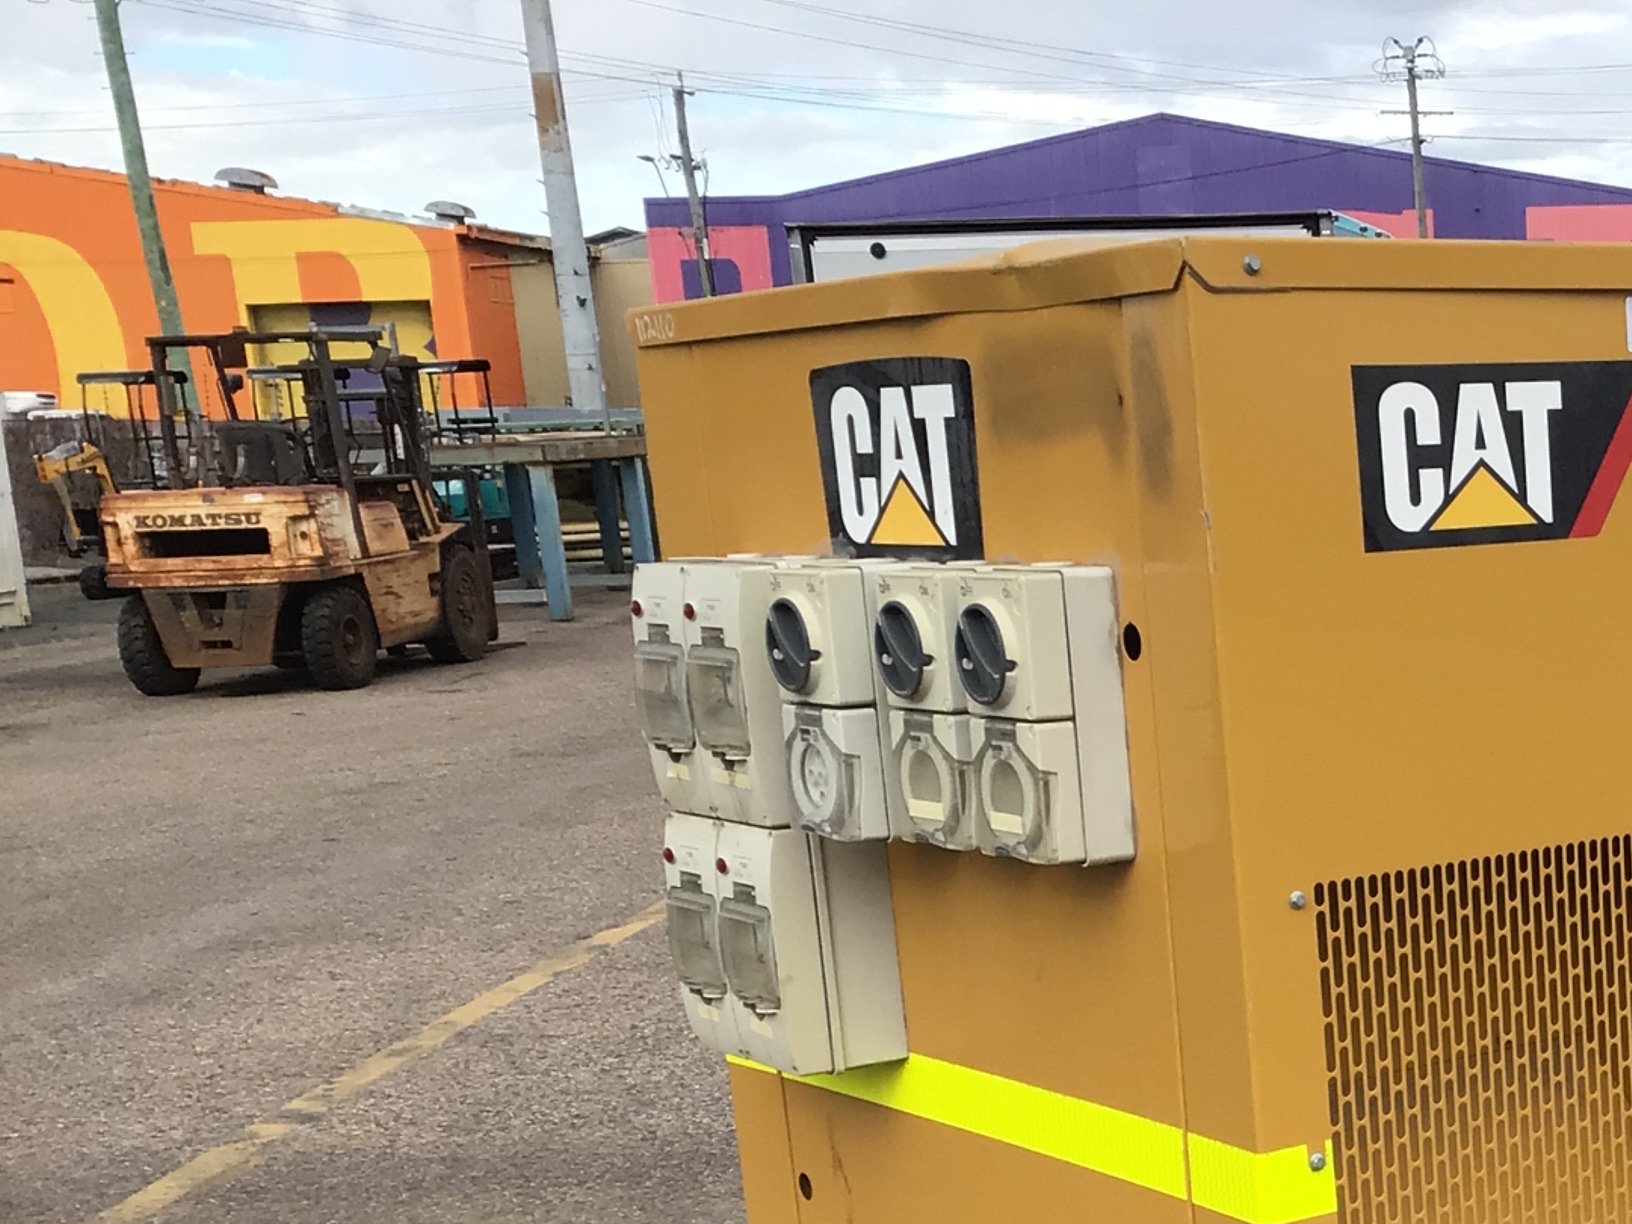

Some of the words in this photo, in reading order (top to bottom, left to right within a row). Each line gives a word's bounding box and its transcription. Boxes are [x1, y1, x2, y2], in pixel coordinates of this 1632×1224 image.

[134, 511, 262, 529] KOMATSU
[830, 383, 958, 546] CAT
[1378, 379, 1563, 533] CAT
